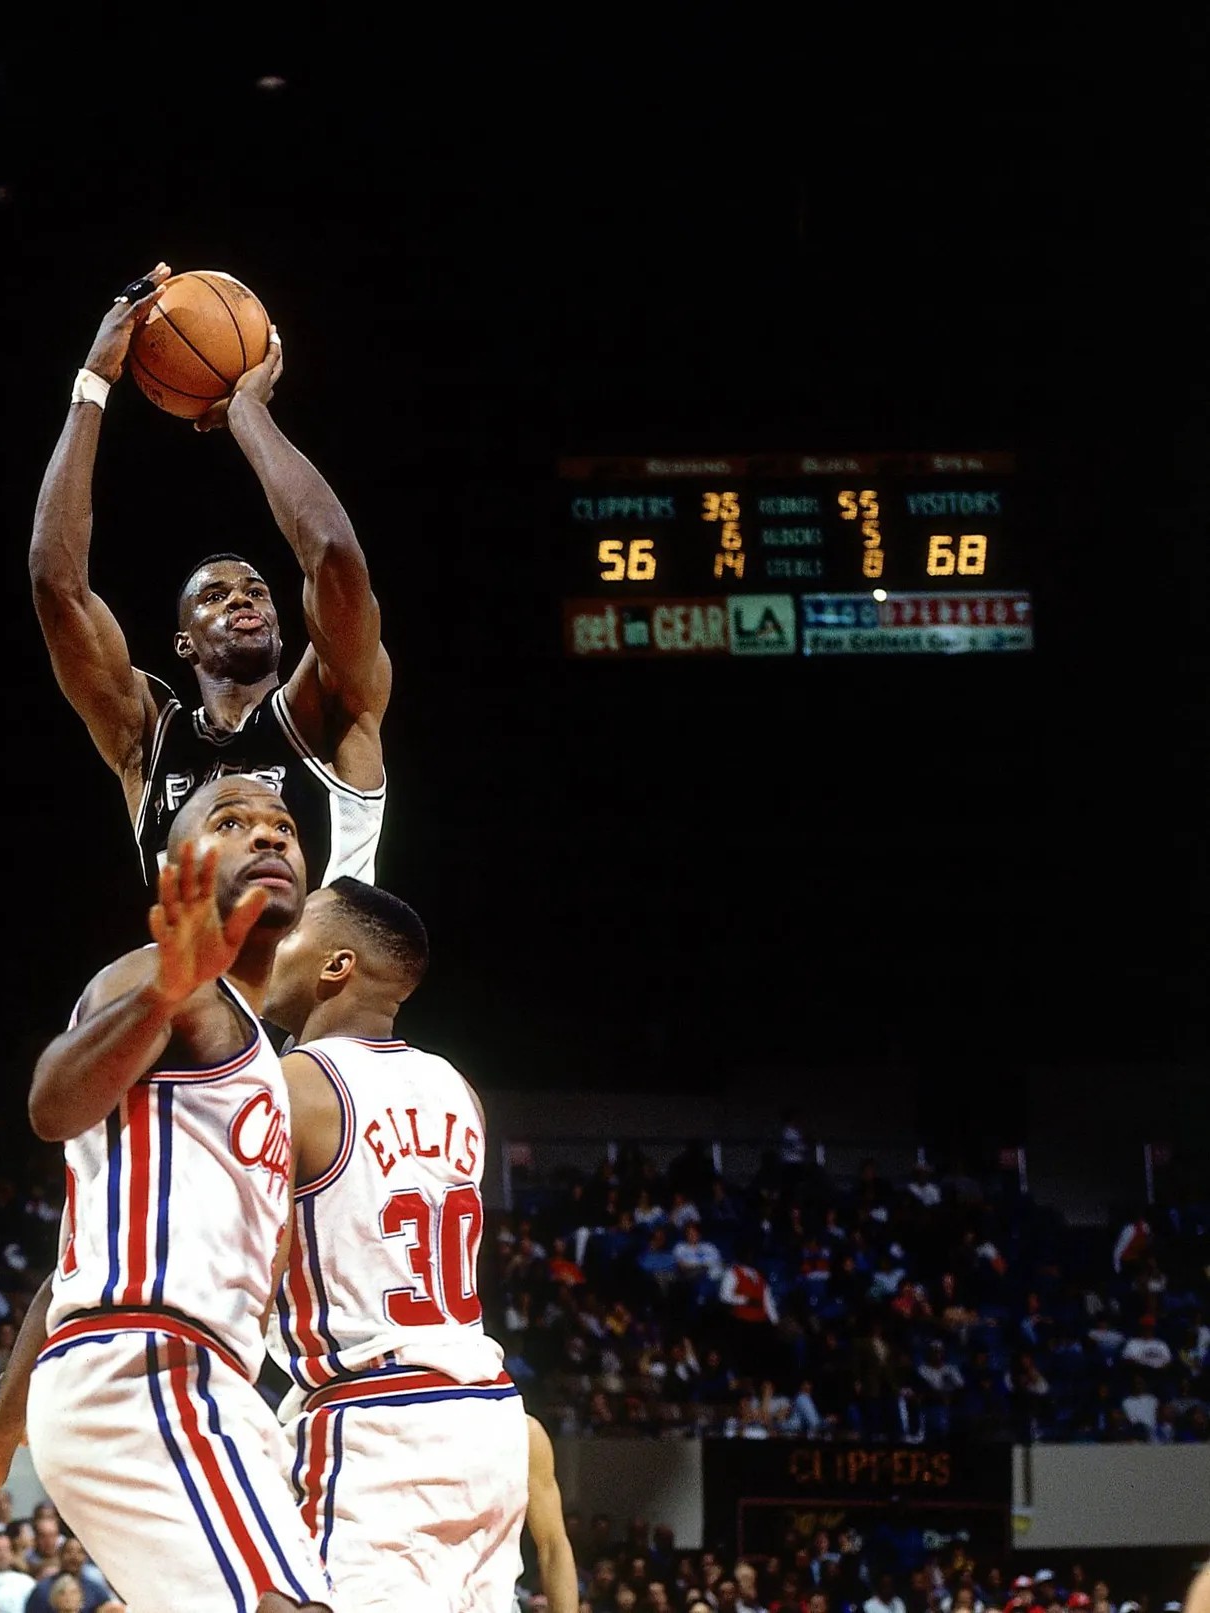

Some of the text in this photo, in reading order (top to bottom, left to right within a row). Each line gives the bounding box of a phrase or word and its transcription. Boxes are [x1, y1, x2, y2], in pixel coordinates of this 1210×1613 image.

[838, 490, 879, 520] 55
[862, 519, 881, 548] 5
[598, 539, 656, 581] 56
[927, 534, 987, 576] 68
[654, 605, 725, 650] GEAR
[364, 1108, 478, 1177] ELLIS
[379, 1182, 484, 1327] 30
